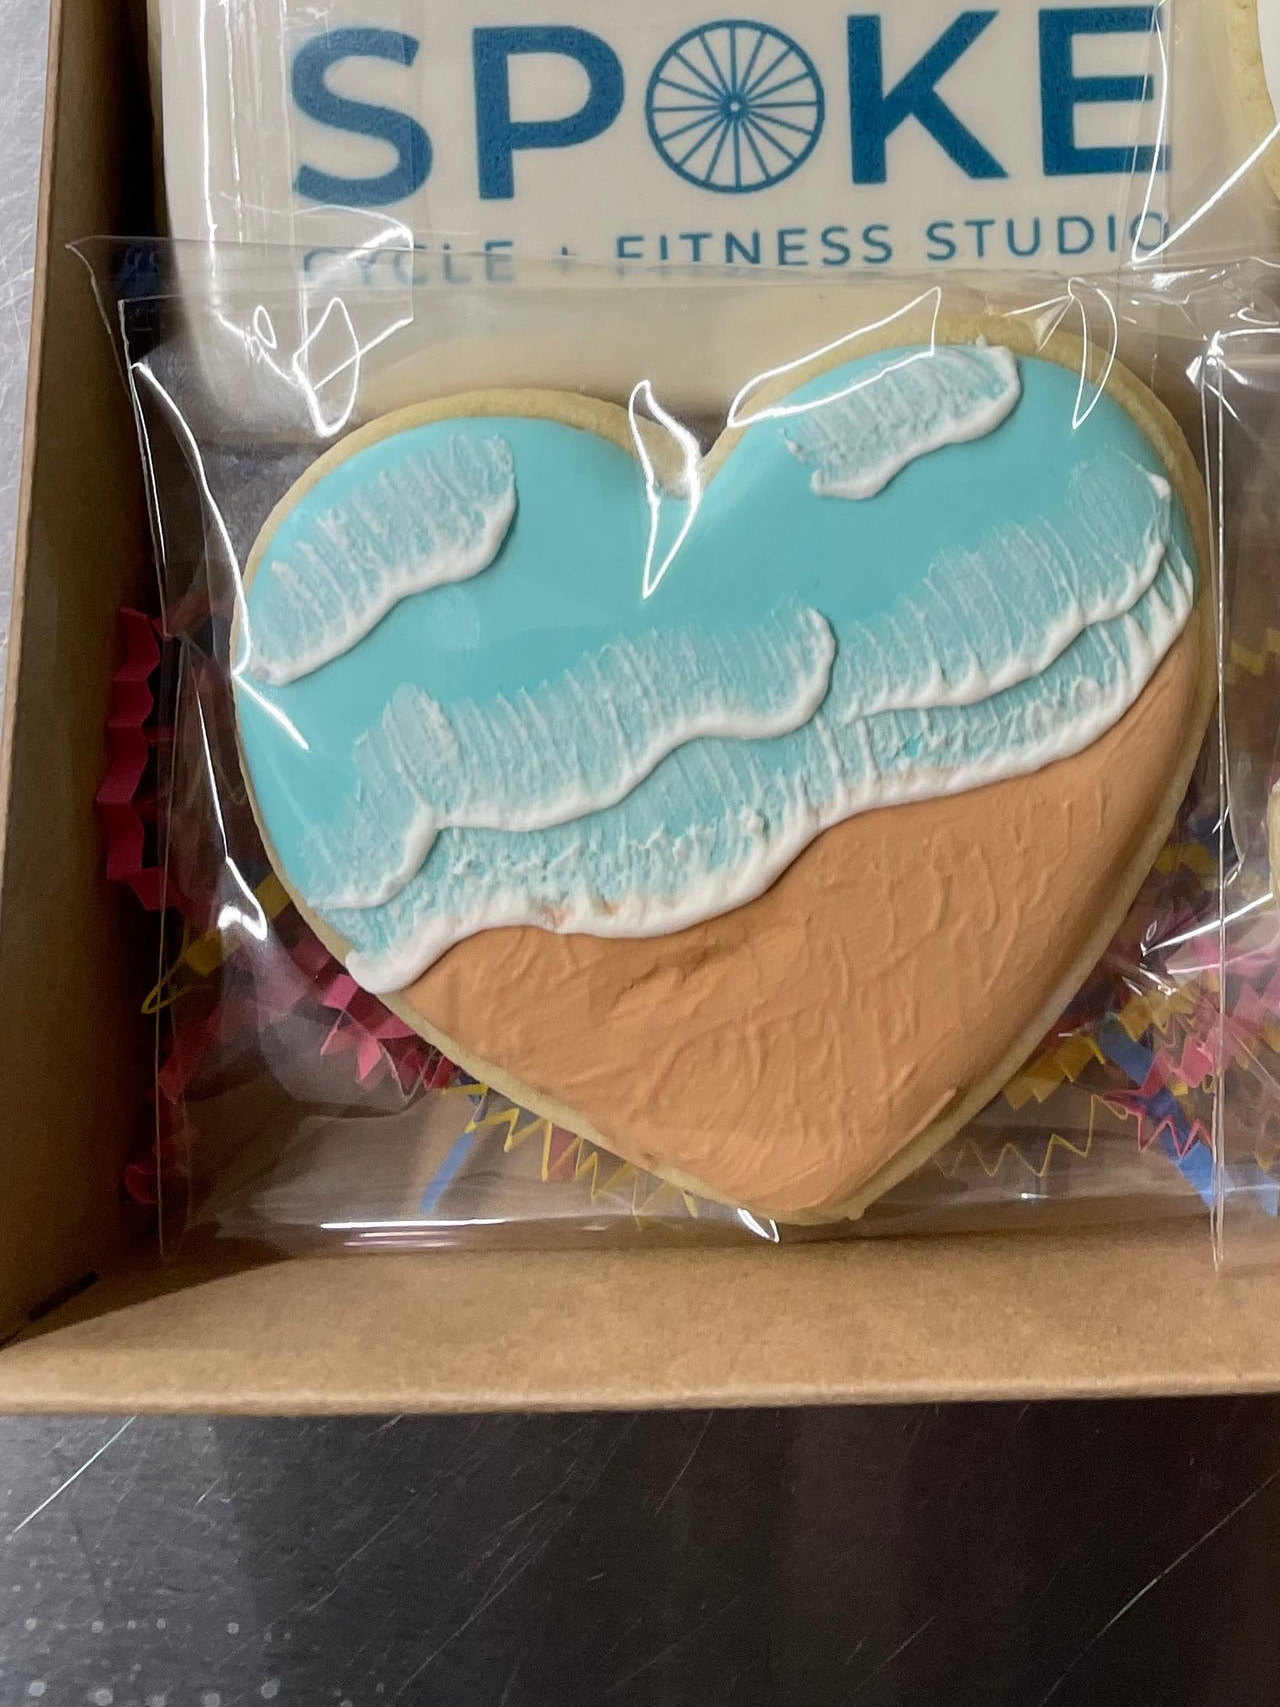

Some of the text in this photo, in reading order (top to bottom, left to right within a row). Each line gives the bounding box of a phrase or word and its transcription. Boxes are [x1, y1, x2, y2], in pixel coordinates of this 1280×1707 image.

[289, 4, 1173, 208] SPOKE
[615, 223, 894, 276] FITNESS
[925, 210, 1171, 263] STUDIO
